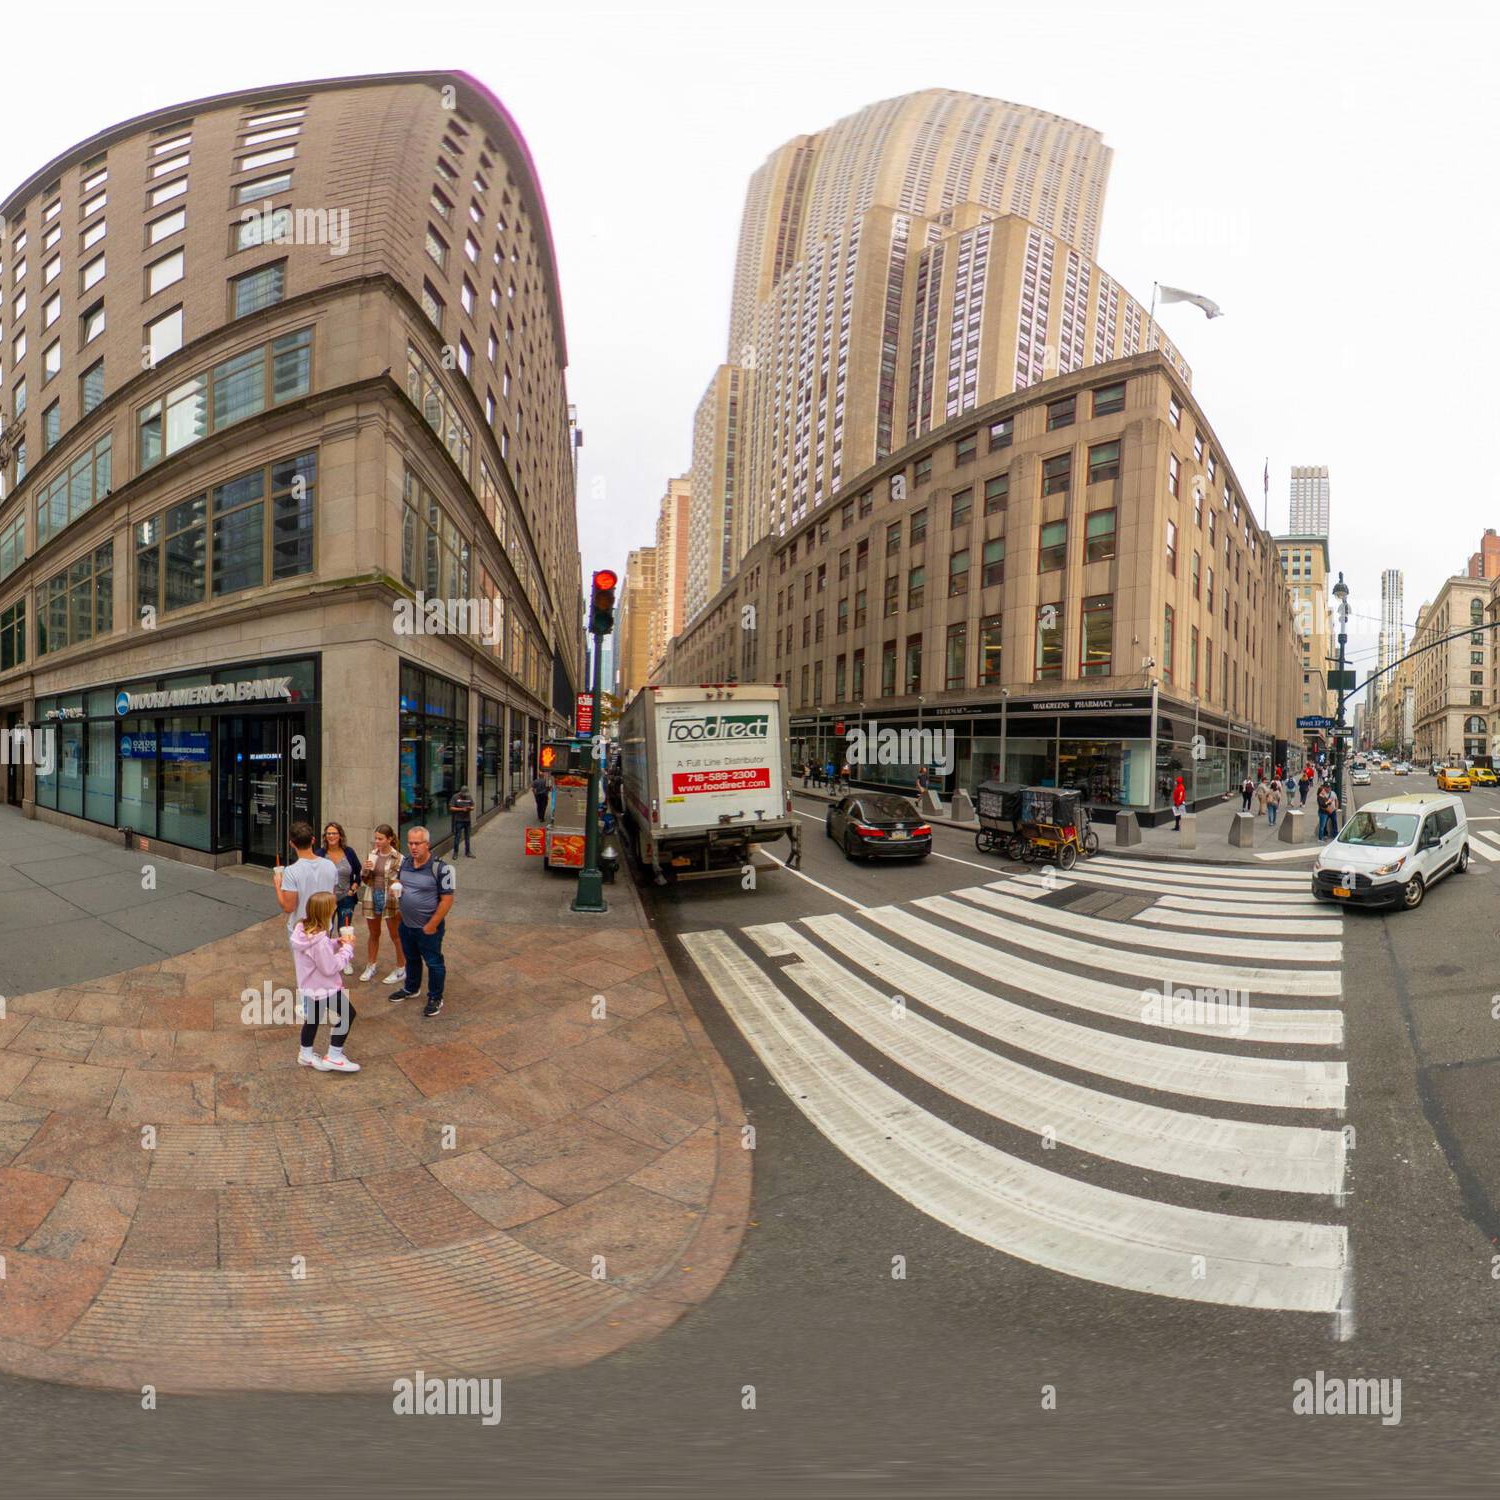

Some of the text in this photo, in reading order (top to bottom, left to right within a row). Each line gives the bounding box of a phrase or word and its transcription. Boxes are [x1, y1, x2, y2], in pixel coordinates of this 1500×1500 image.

[1032, 702, 1070, 710] WALGREENS
[1074, 700, 1114, 709] PHARMACY
[668, 716, 769, 740] foodirect
[686, 759, 701, 767] Full
[704, 758, 721, 767] Line
[724, 756, 765, 766] Distributor
[686, 770, 757, 783] 718-589-2300
[677, 780, 766, 793] www.foodirect.com
